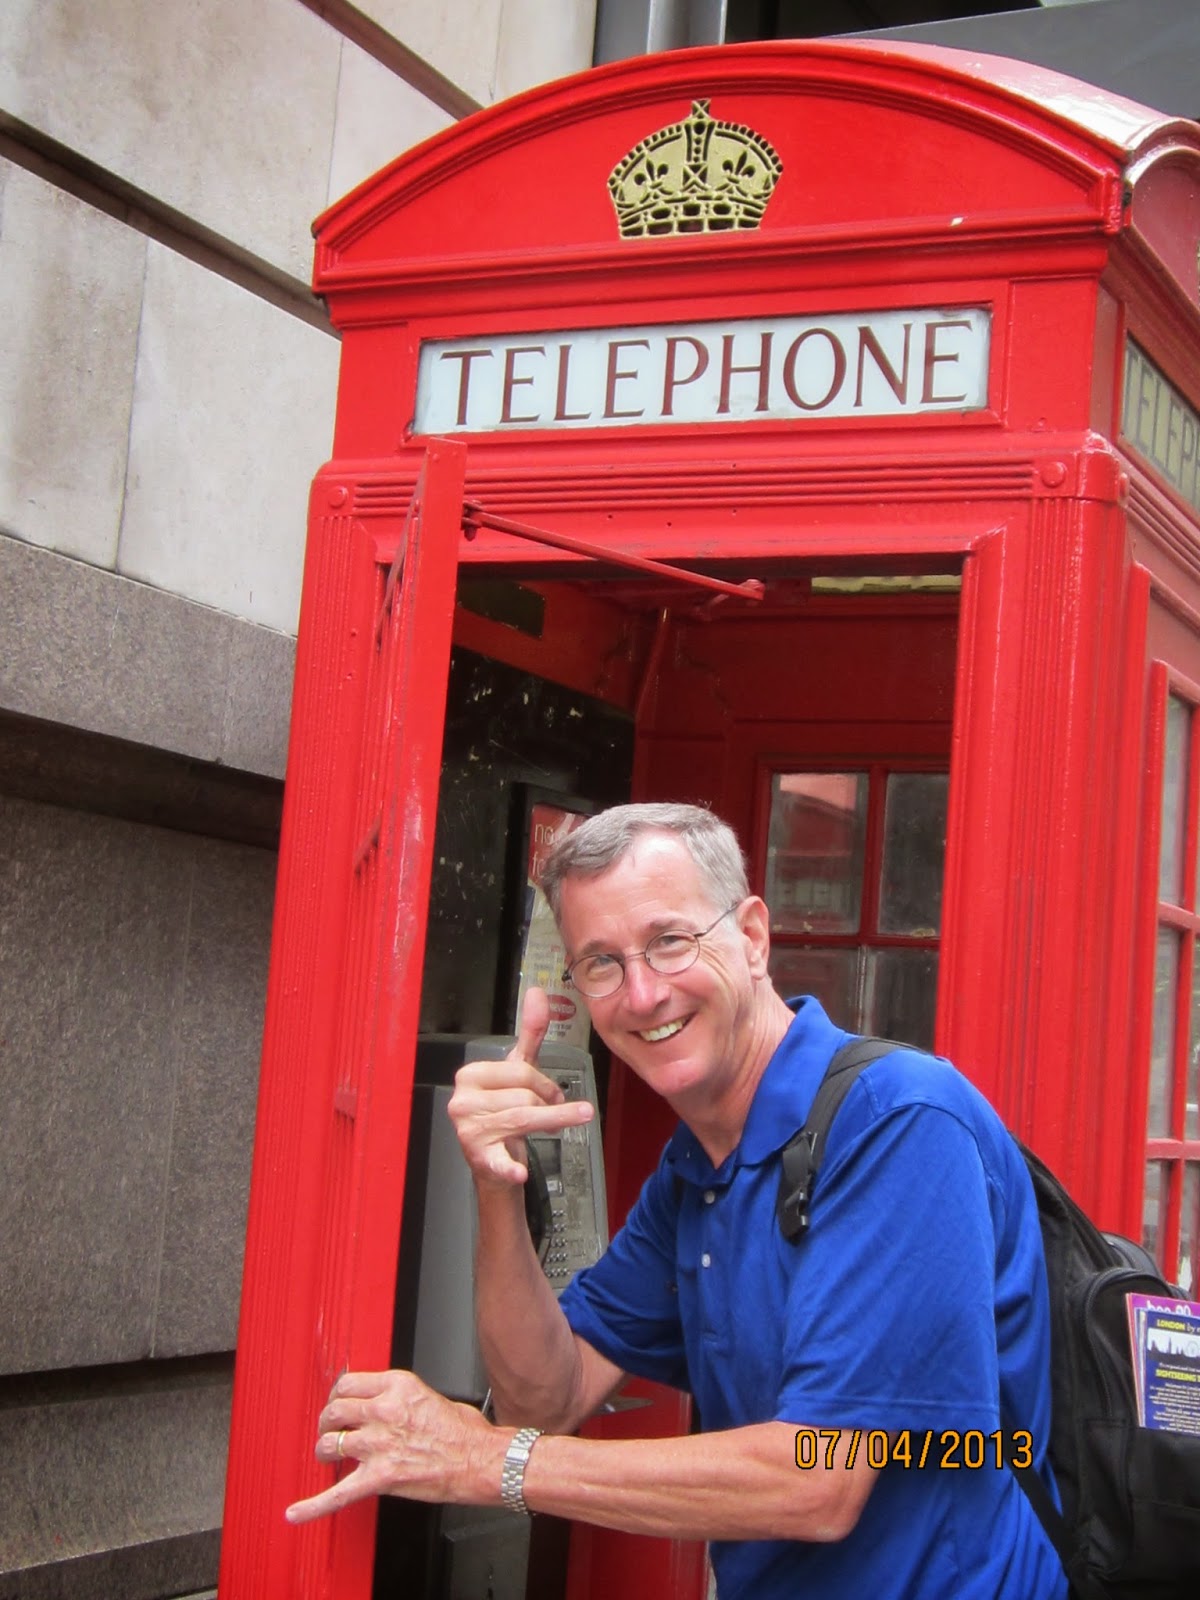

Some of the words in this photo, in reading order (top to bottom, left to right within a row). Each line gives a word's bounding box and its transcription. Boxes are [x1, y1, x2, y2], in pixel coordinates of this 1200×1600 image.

[440, 320, 972, 427] TELEPHONE
[1157, 1319, 1185, 1330] LONDON
[1187, 1322, 1195, 1335] by
